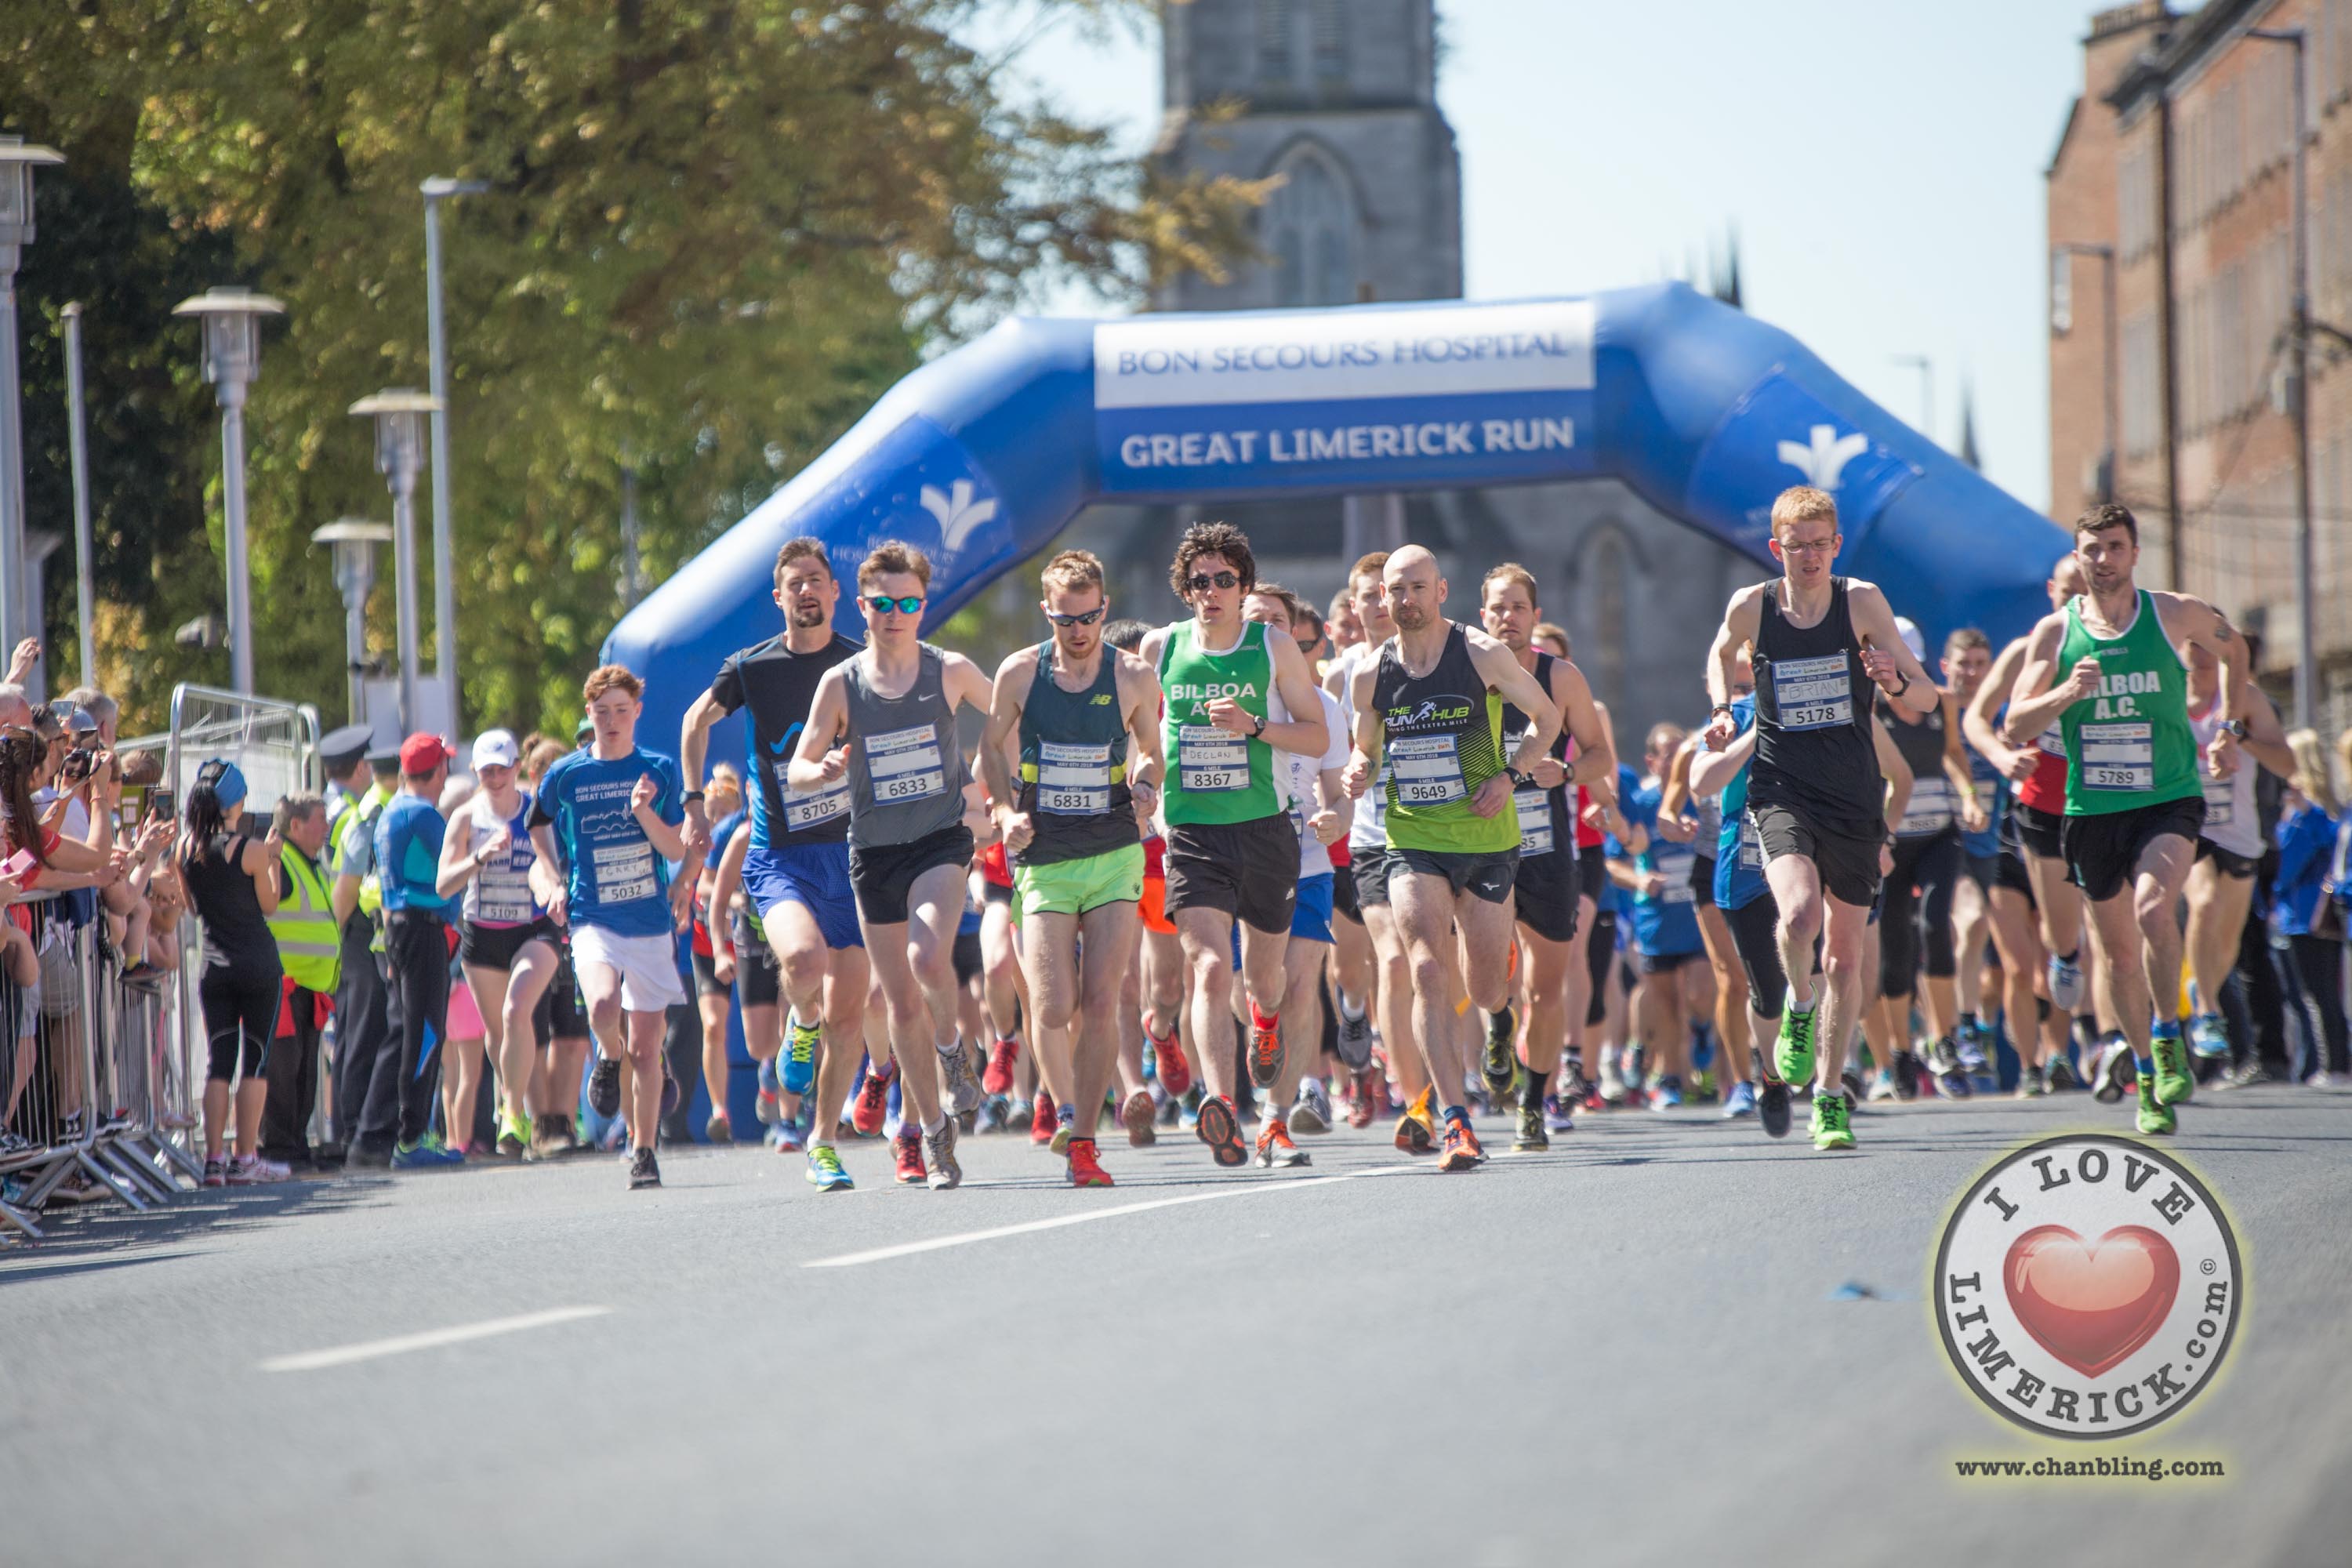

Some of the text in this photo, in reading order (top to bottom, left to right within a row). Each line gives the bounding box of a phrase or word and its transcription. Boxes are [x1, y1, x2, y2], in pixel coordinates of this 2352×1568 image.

[1117, 332, 1569, 376] BON SECOURS HOSPITAL
[1120, 417, 1574, 467] GREAT LIMERICK RUN
[1171, 683, 1257, 700] BILBOA
[1788, 680, 1839, 699] BRIAN
[1388, 706, 1411, 717] THE
[1796, 707, 1835, 724] 5178
[2094, 696, 2141, 720] A.C.
[1385, 706, 1470, 728] RUN HUB
[1190, 750, 1230, 759] DECLAN
[1194, 773, 1231, 787] 8367
[2098, 770, 2134, 784] 5789
[889, 778, 927, 796] 6833
[1411, 785, 1447, 799] 9649
[575, 789, 632, 803] GREAT LIMERIC
[1054, 795, 1091, 808] 6831
[802, 800, 837, 820] 8705
[612, 884, 642, 900] 5032
